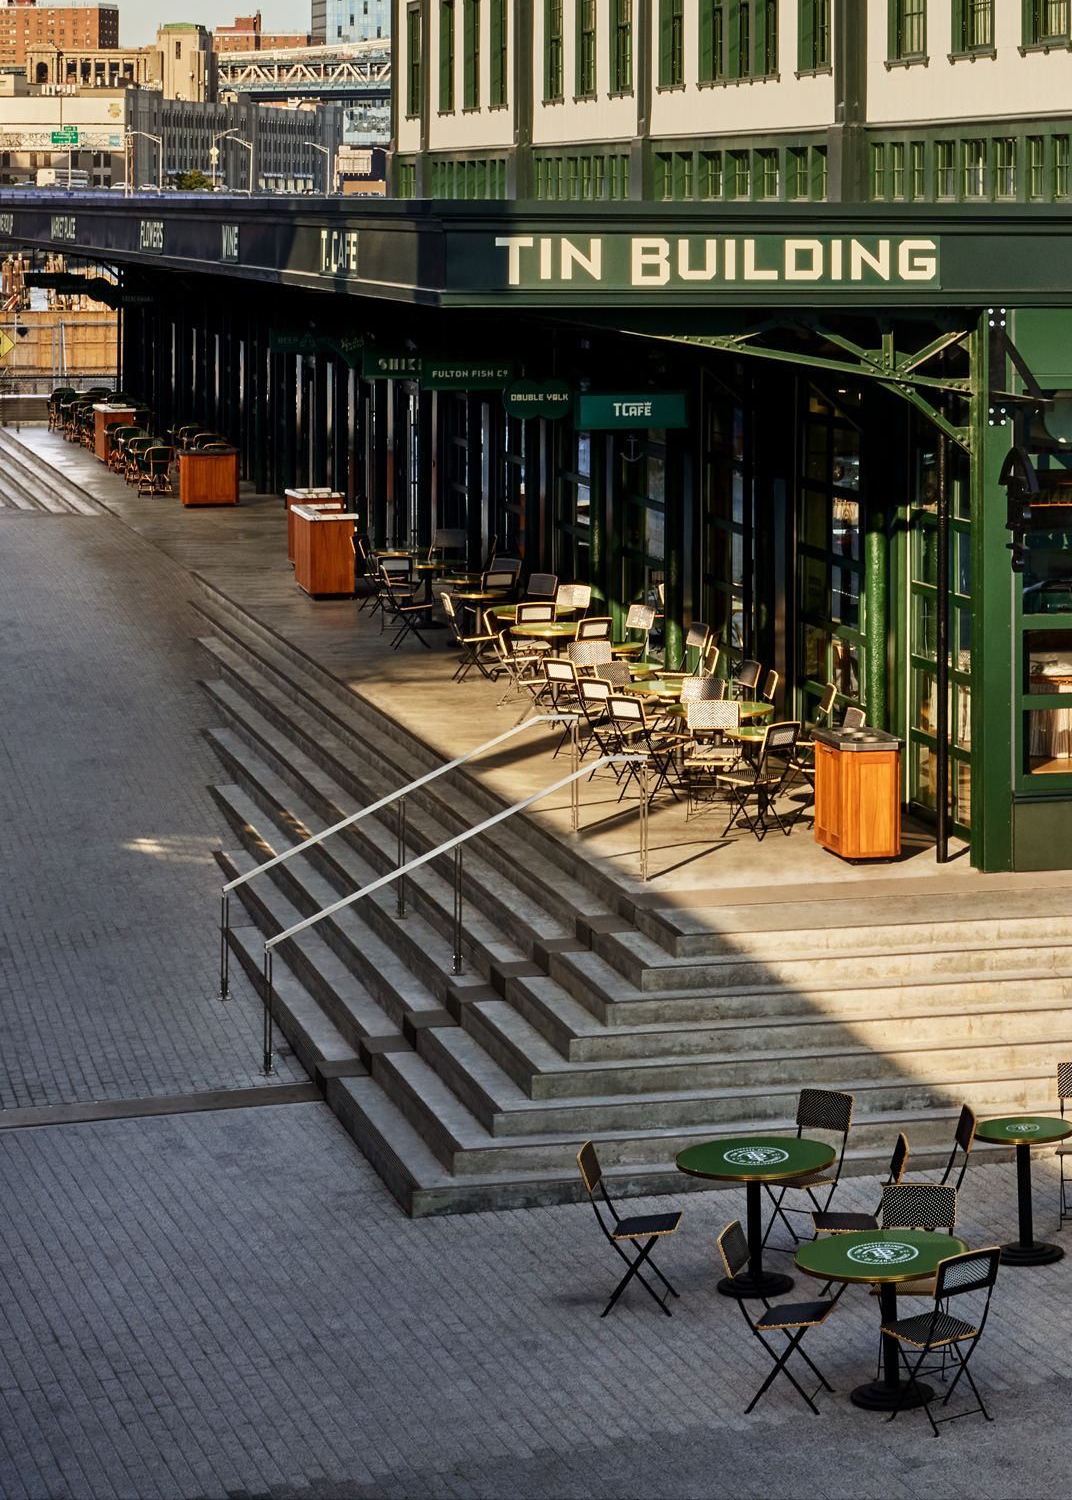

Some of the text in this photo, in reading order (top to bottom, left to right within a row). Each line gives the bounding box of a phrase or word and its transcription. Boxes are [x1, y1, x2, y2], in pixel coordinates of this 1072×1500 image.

[140, 220, 164, 250] FLOWERS
[221, 225, 239, 260] WINE
[321, 230, 358, 273] T. CAFE
[495, 237, 937, 286] TIN BUILDING
[432, 370, 469, 378] FULTON
[471, 369, 494, 378] FISH
[511, 393, 569, 401] DOUBLE YOLK
